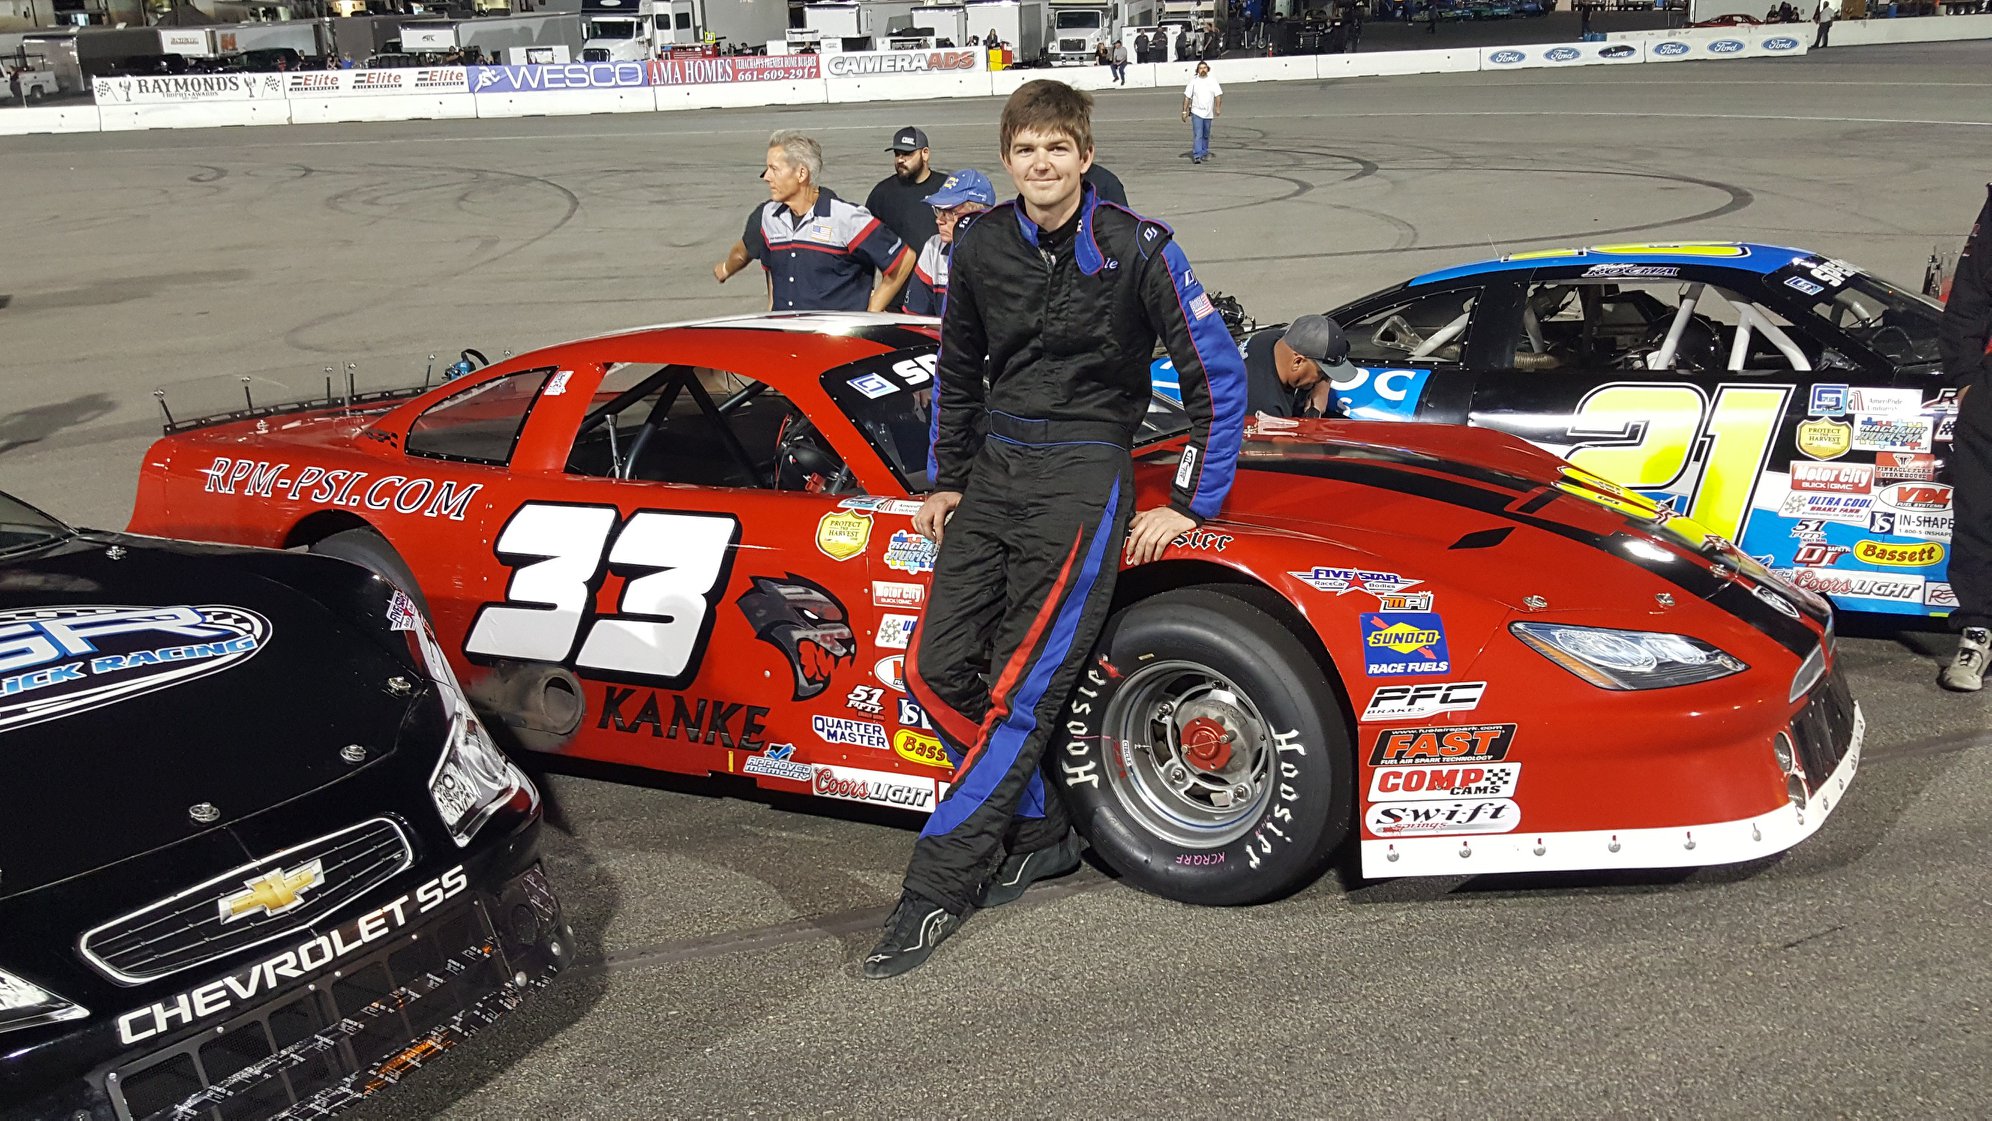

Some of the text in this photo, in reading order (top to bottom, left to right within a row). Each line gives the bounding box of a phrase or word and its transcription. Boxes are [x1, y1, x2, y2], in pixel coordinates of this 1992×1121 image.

[1659, 44, 1682, 54] Ford
[1714, 42, 1737, 52] Ford
[1768, 39, 1792, 49] Ford
[1495, 52, 1519, 63] Ford
[1550, 49, 1573, 60] Ford
[366, 72, 402, 84] Elite
[429, 70, 464, 82] Elite
[505, 63, 643, 89] WESCO
[651, 59, 733, 85] AMA HOMES
[737, 68, 816, 81] 661-609-2917
[136, 76, 239, 94] RAYMOND'S
[303, 75, 339, 86] Elite
[1144, 226, 1158, 242] DJ
[1565, 381, 1797, 548] 21
[1794, 463, 1872, 488] Motor City
[205, 457, 483, 521] RPM-PSI.COM
[1808, 495, 1873, 508] ULTRA COOL
[830, 520, 862, 528] PROTECT
[1792, 519, 1827, 532] 51
[828, 530, 860, 538] HARVEST
[1862, 544, 1936, 563] Bassett
[1313, 568, 1400, 583] FIVE STAR
[1794, 570, 1852, 593] Coors
[1852, 579, 1921, 599] LIGHT
[462, 500, 743, 690] 33
[1371, 631, 1437, 645] SUNOCO
[0, 634, 259, 698] ICK RACING
[1368, 661, 1449, 675] RACE FUELS
[847, 685, 886, 705] 51
[1370, 683, 1484, 708] PFC
[846, 700, 884, 713] FIFTY
[1366, 706, 1425, 714] BRAKES
[597, 685, 771, 752] KANKE
[814, 716, 882, 736] QUARTER
[826, 729, 886, 748] MASTER
[1384, 730, 1501, 759] FAST
[903, 735, 944, 762] Bass
[747, 757, 811, 773] APPROVED
[1442, 755, 1494, 763] TECHNOLOGY
[814, 767, 933, 807] Coors LIGHT
[1378, 768, 1485, 793] COMP
[1450, 785, 1501, 796] CAMS
[116, 864, 469, 1046] CHEVROLET SS
